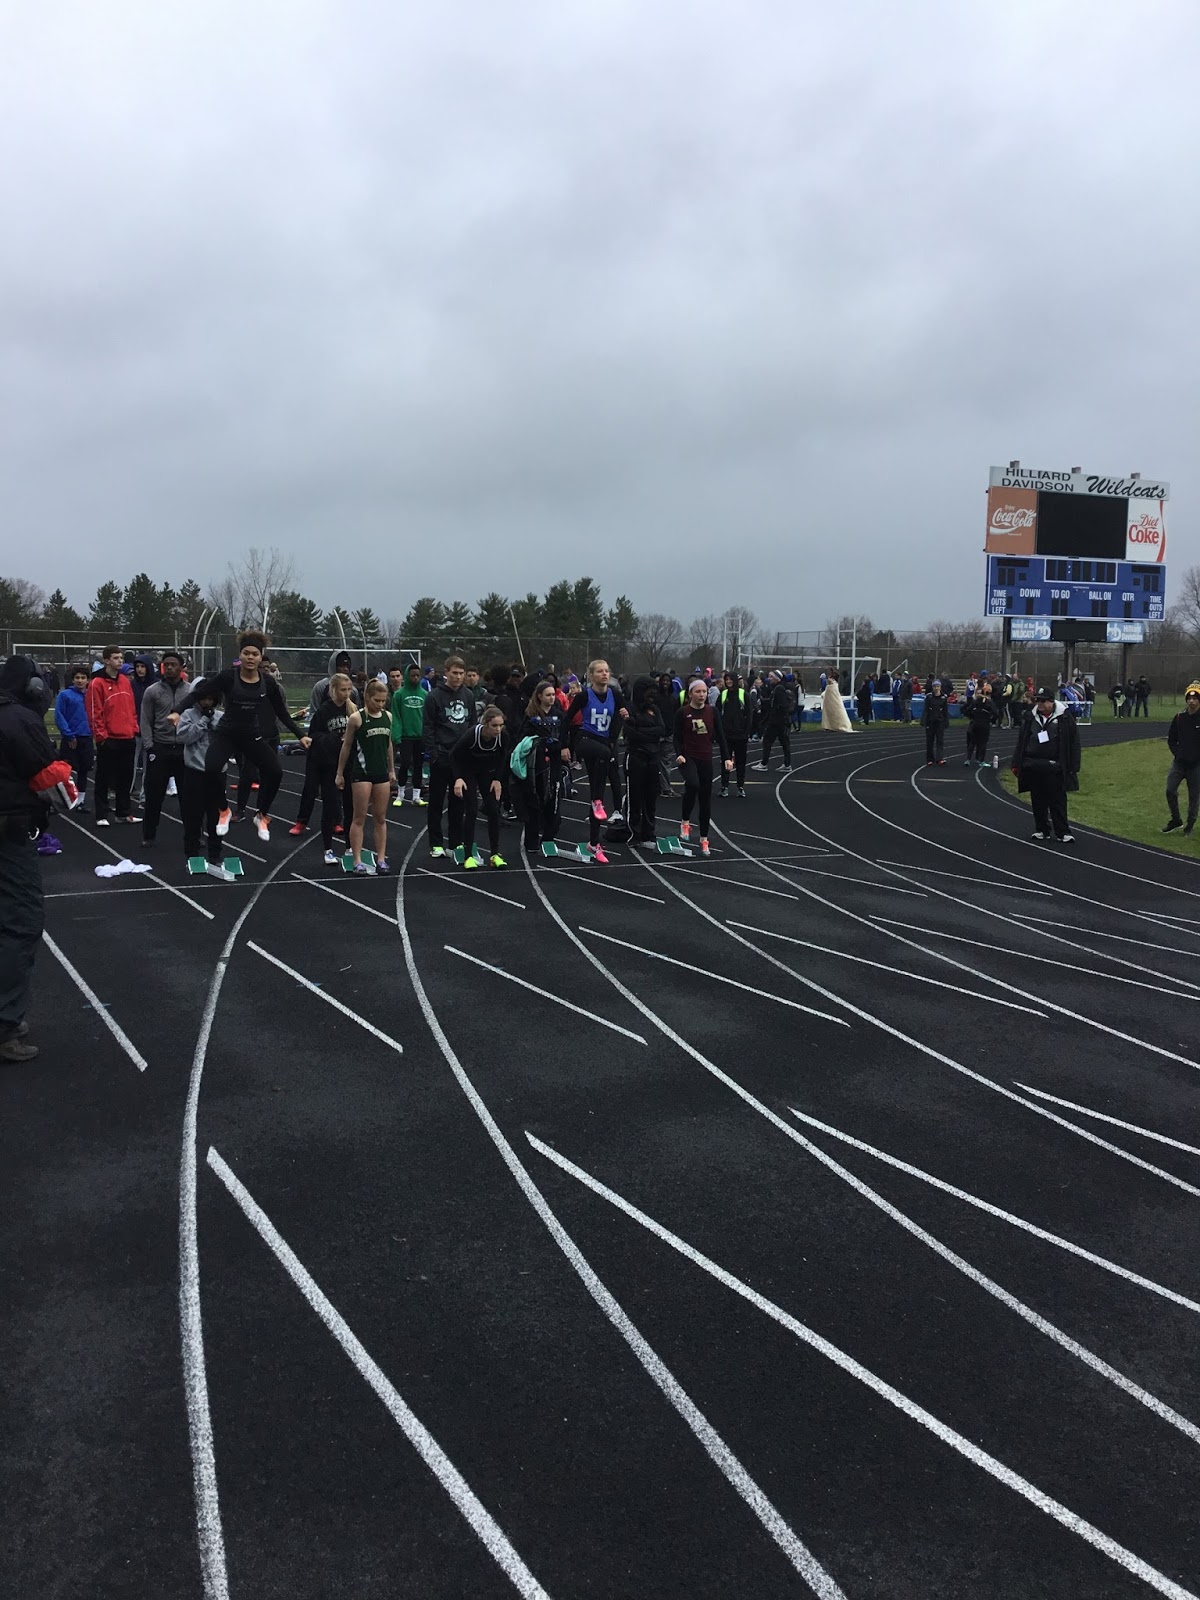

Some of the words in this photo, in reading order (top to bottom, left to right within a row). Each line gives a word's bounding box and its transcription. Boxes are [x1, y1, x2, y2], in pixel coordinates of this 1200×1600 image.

[1005, 467, 1072, 482] HILLIARD
[1001, 477, 1075, 493] DAVIDSON
[1086, 475, 1167, 499] Wildcats
[1138, 513, 1160, 528] Diet
[1128, 524, 1160, 545] Coke
[993, 589, 1007, 598] TIME
[1019, 588, 1041, 598] DOWN
[1050, 589, 1060, 599] TO
[1060, 589, 1071, 600] GO
[1088, 590, 1103, 601] BALL
[1103, 591, 1112, 601] ON
[1121, 592, 1135, 602] QTR
[991, 597, 1007, 606] OUTS
[1149, 595, 1162, 604] TIME
[991, 606, 1006, 615] LEFT
[1149, 603, 1163, 612] OUTS
[1148, 611, 1161, 619] LEFT
[1011, 629, 1035, 639] WILDCATS
